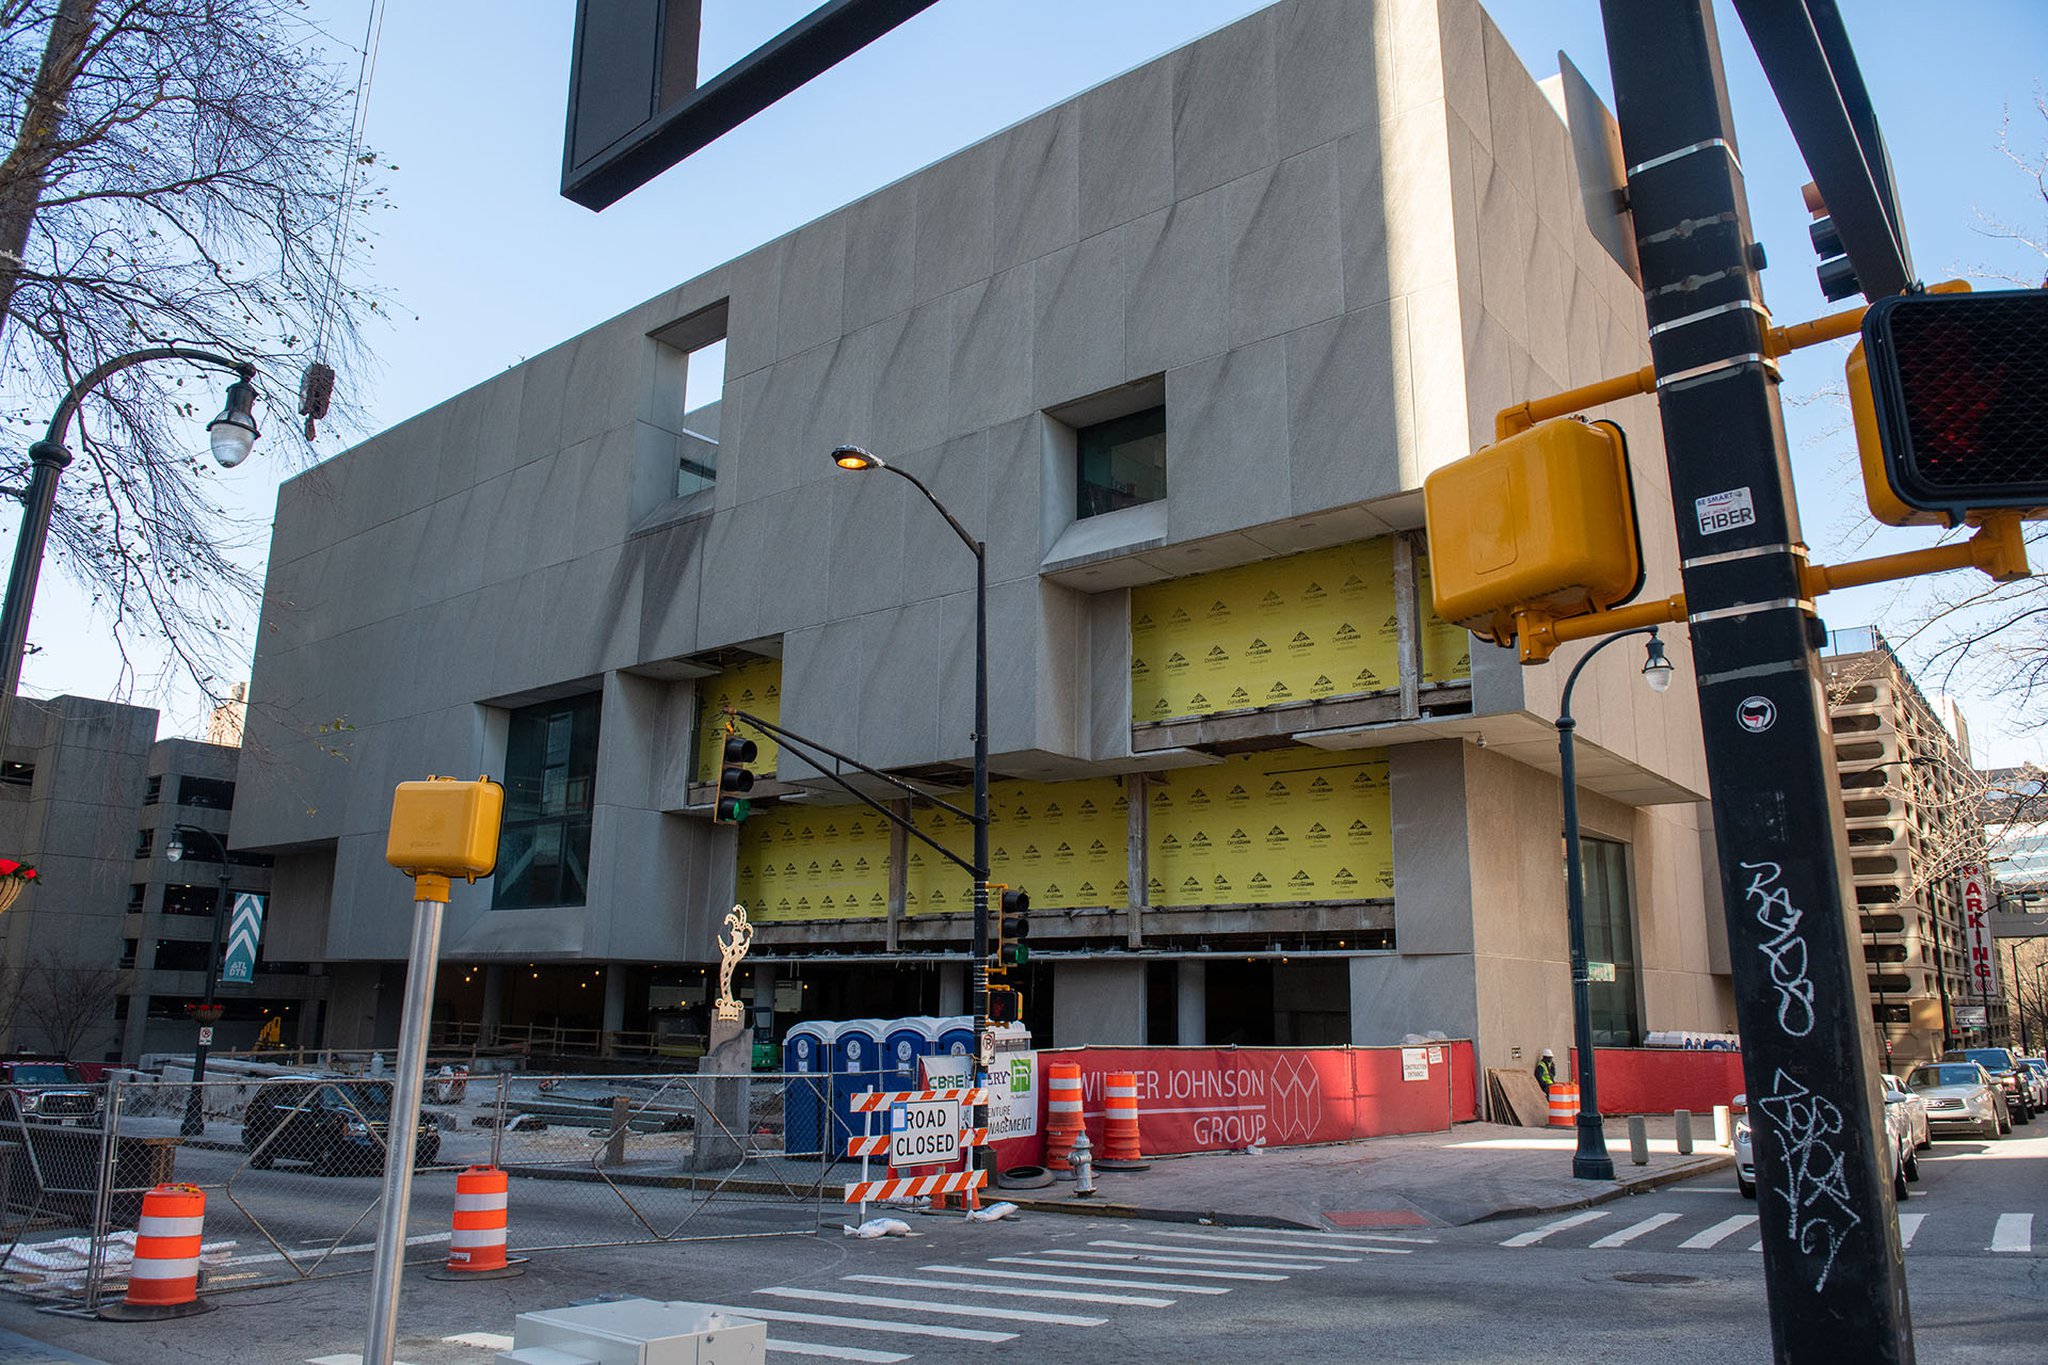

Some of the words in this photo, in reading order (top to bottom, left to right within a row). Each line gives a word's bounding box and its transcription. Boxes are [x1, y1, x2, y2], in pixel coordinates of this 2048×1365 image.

[1697, 499, 1706, 507] BE
[1707, 492, 1733, 504] SMART
[1700, 507, 1753, 532] FIBER
[1962, 866, 1991, 978] PARKING
[229, 968, 247, 977] DTN
[928, 1074, 964, 1090] CBRE
[1165, 1069, 1264, 1100] JOHNSON
[906, 1108, 947, 1130] ROAD
[988, 1105, 1012, 1118] ENTURE
[988, 1116, 1032, 1135] NAGEMENT
[1193, 1114, 1267, 1146] GROUP
[896, 1133, 955, 1157] CLOSED
